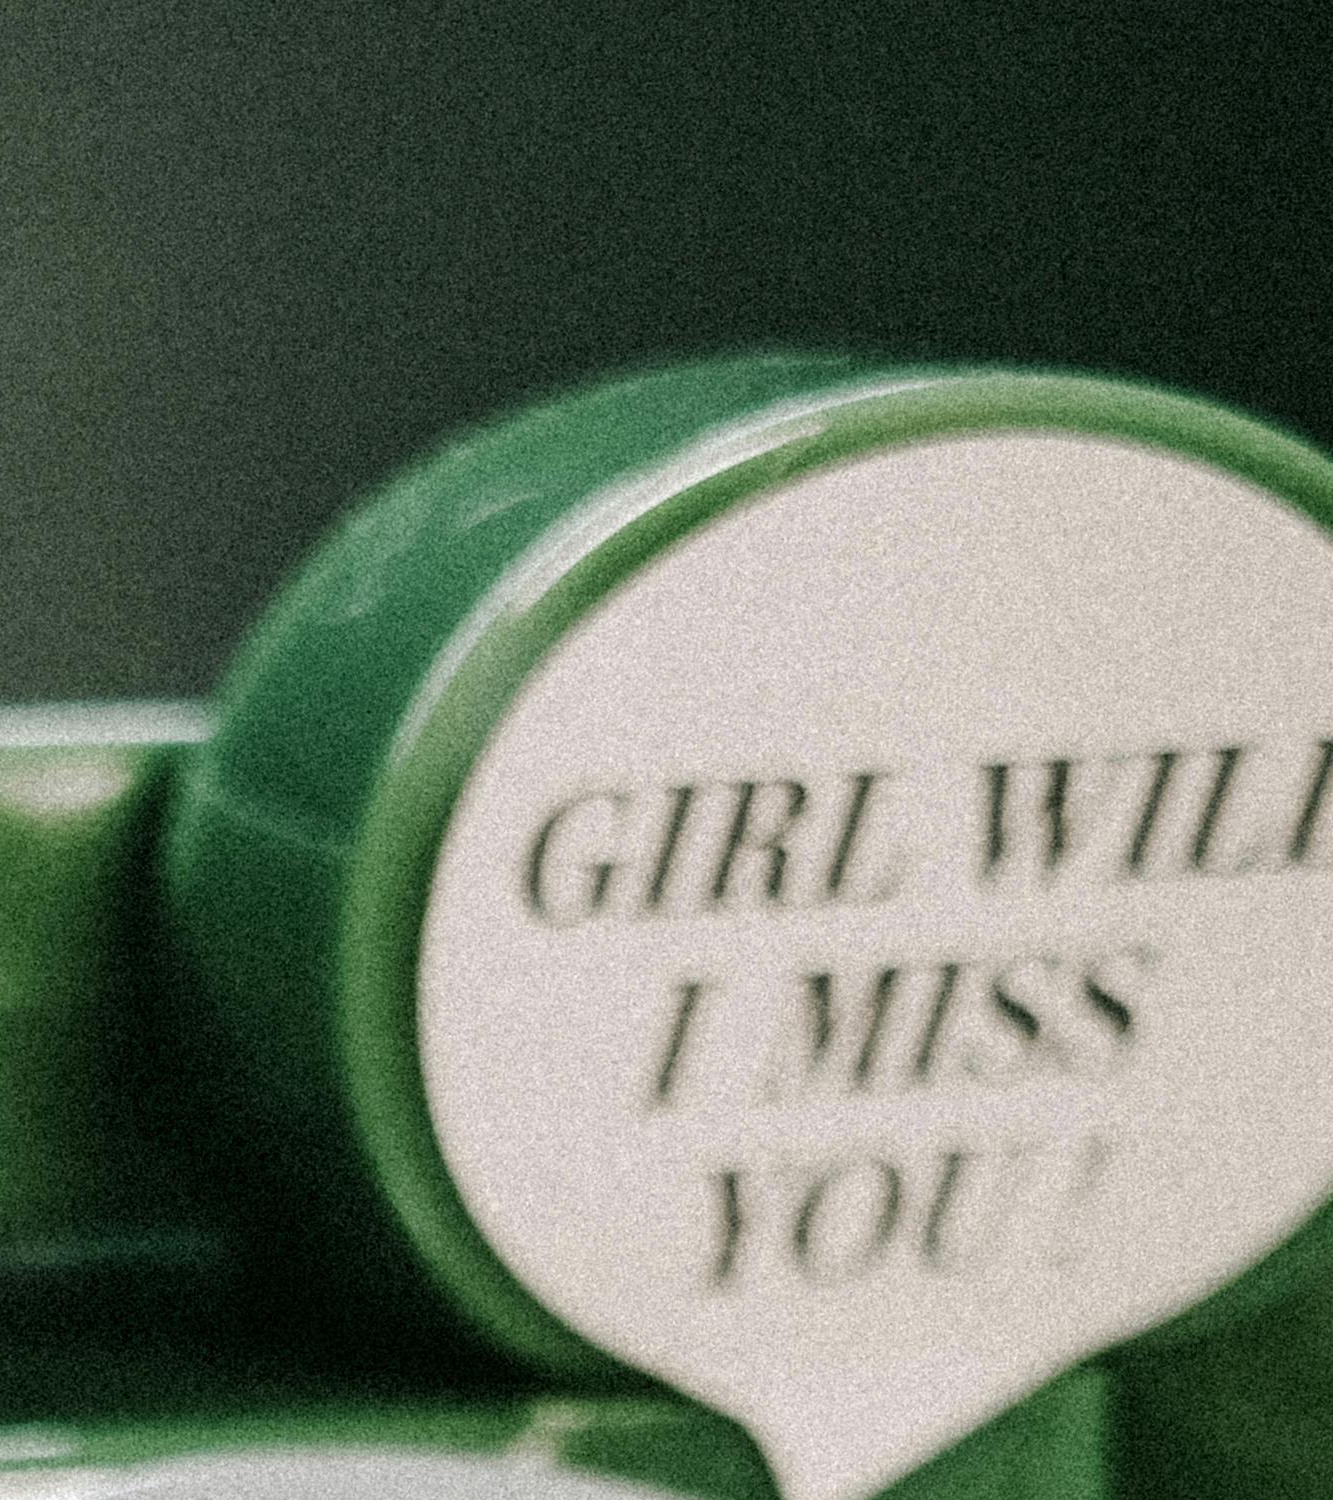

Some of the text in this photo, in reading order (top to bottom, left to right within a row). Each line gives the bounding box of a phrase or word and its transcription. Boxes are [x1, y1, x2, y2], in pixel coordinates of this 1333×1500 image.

[519, 766, 910, 930] GIRL
[635, 940, 1166, 1118] I MISS
